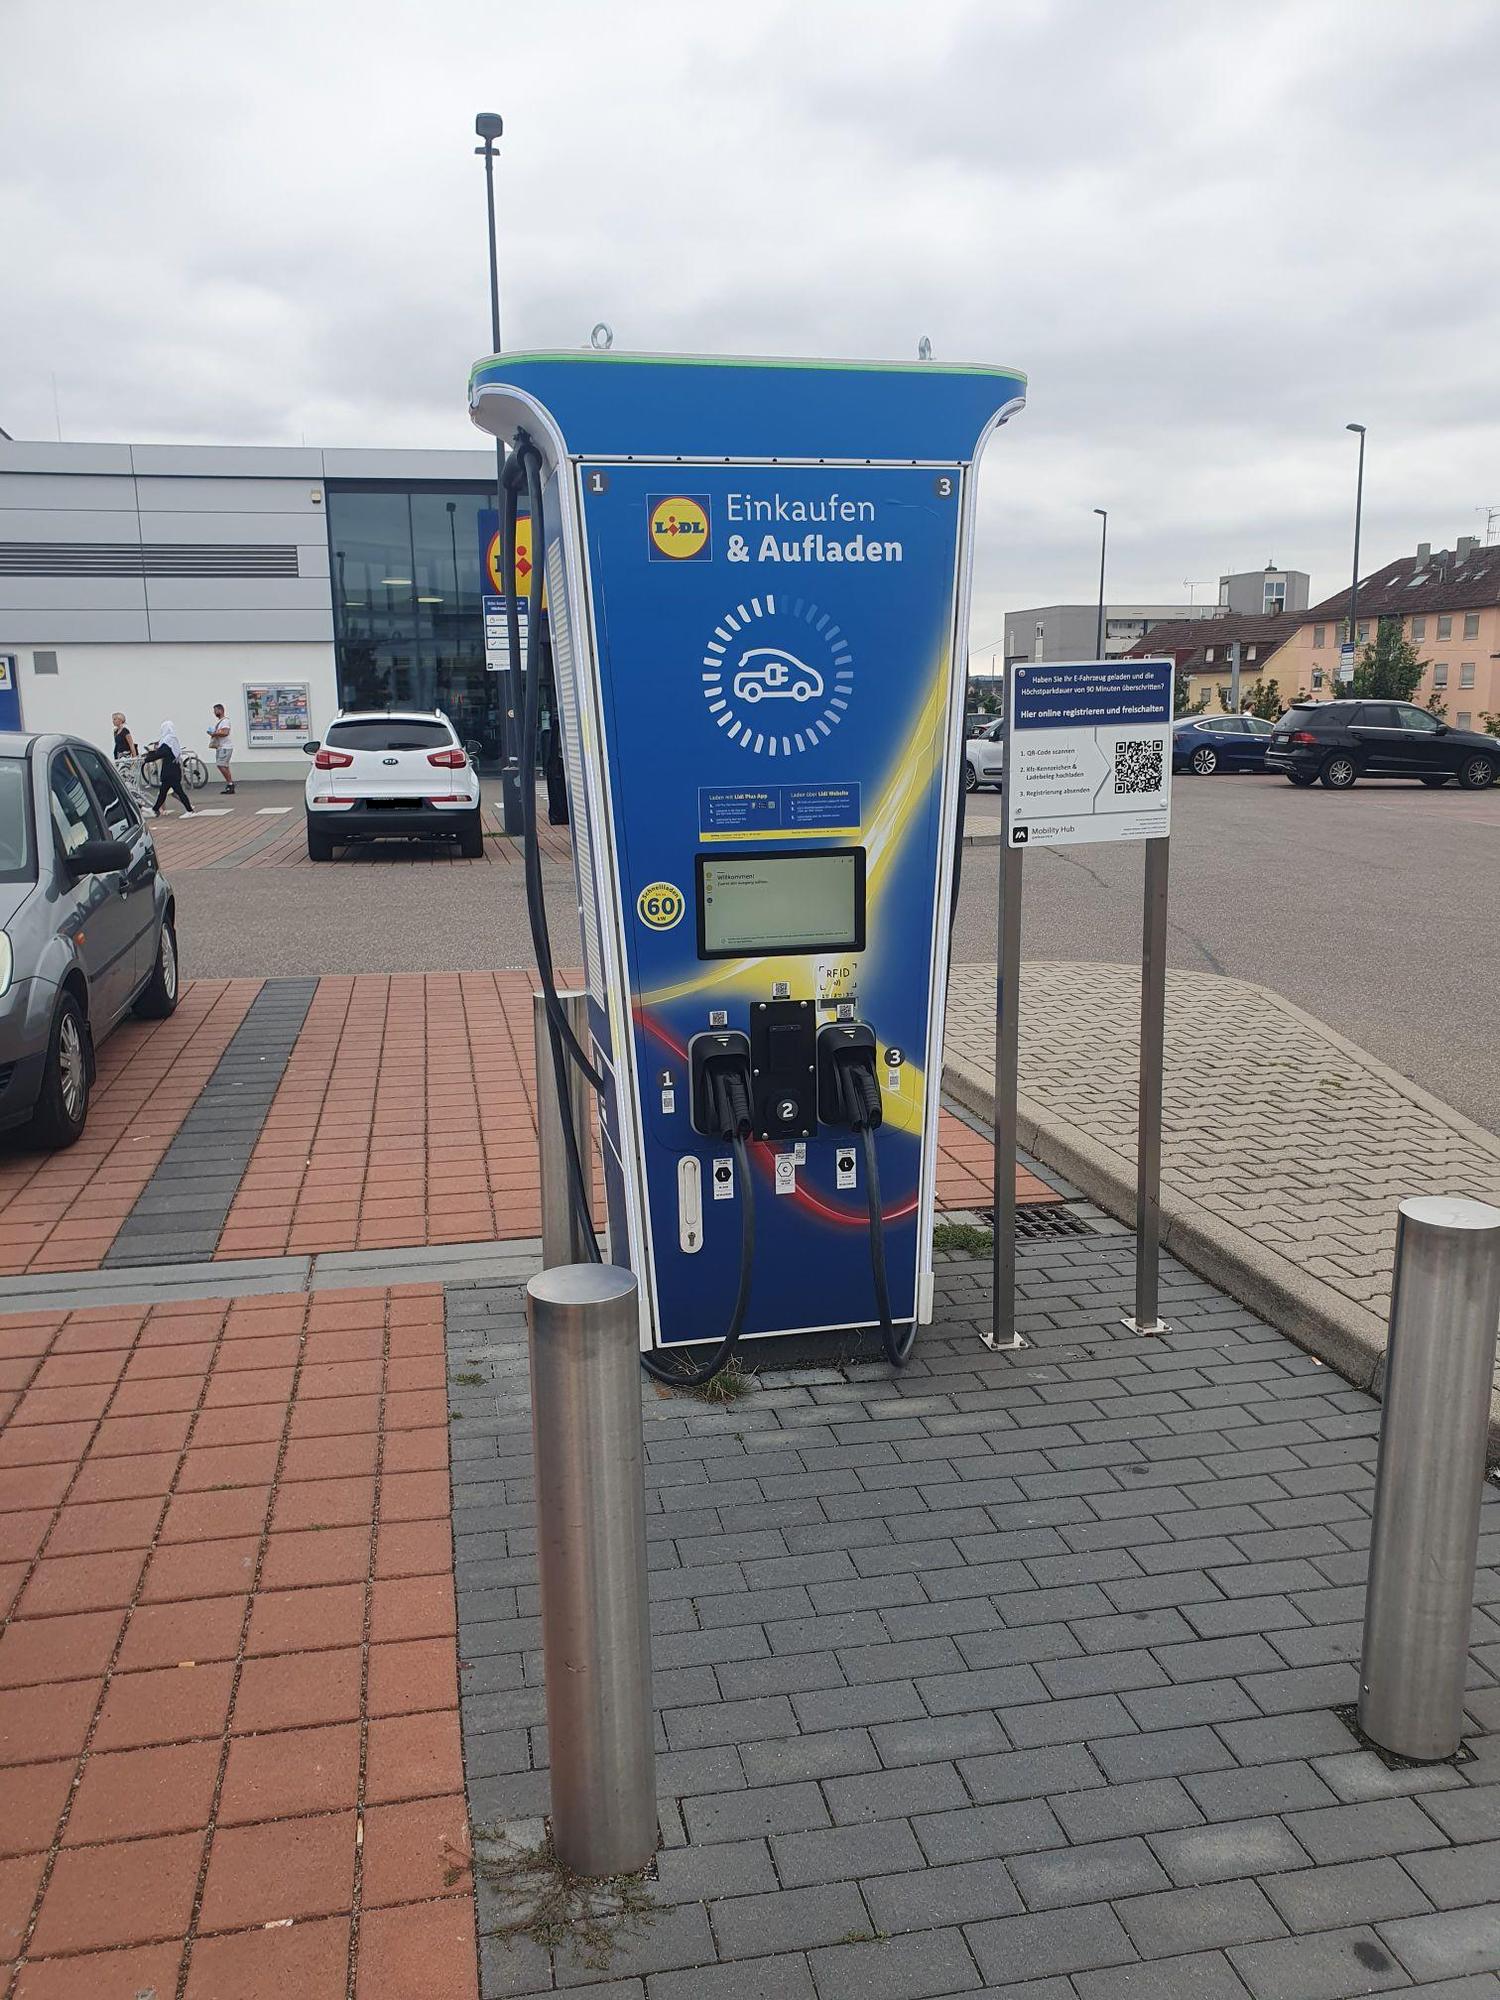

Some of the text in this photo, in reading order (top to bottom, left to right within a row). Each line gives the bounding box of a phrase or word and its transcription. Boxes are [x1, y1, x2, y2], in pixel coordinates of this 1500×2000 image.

[592, 473, 604, 492] 1
[939, 478, 951, 496] 3
[727, 494, 875, 522] Einkaufen
[727, 534, 903, 563] & Aufladen
[1032, 671, 1155, 684] Haben Sie Ihr E-Fahrzeug geladen und die
[1021, 686, 1073, 696] Höchstparkdauer
[1086, 685, 1095, 693] 90
[1096, 684, 1121, 693] Minuten
[1122, 683, 1165, 693] überschritten?
[1020, 704, 1164, 719] Hier online registrieren und freischalten
[1026, 749, 1051, 757] QR-Code
[1056, 771, 1084, 779] hochladen
[1026, 788, 1063, 798] Registrierung
[1063, 787, 1090, 795] absenden
[1031, 825, 1075, 836] Mobility Hub
[648, 897, 675, 915] 60
[826, 967, 850, 978] RFID
[889, 1049, 901, 1065] 3
[662, 1070, 673, 1087] 1
[782, 1101, 794, 1118] 2
